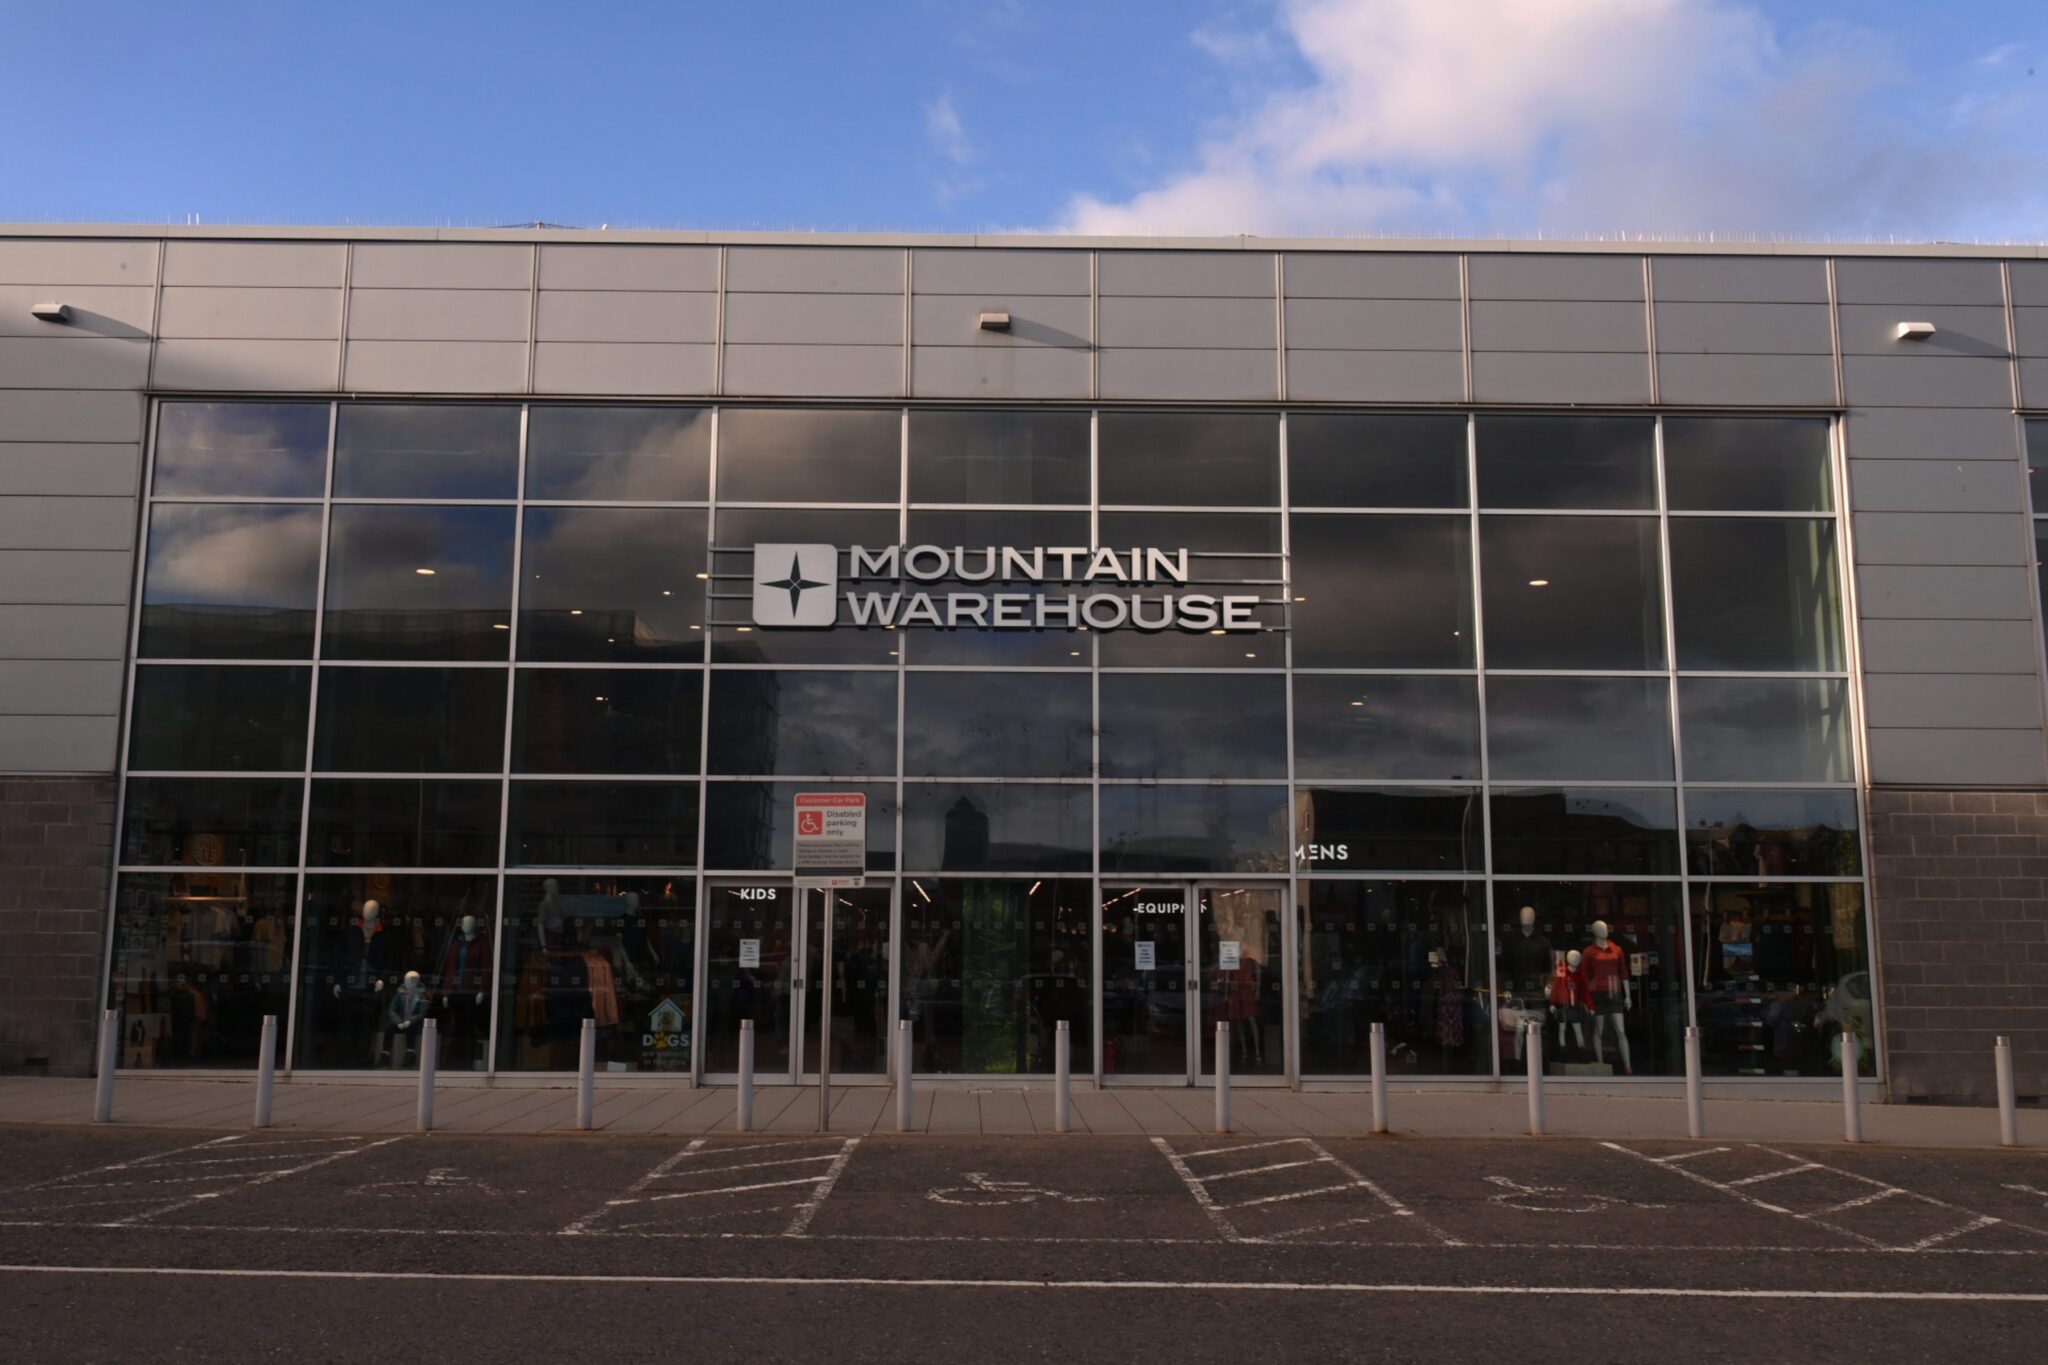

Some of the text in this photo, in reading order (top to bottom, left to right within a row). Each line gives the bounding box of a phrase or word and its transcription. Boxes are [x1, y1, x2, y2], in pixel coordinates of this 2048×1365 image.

[850, 544, 1188, 582] MOUNTAIN
[846, 592, 1262, 630] WAREHOUSE
[826, 810, 862, 818] Disabled
[826, 819, 857, 828] parking
[826, 829, 844, 837] only
[1294, 844, 1349, 860] MENS
[740, 888, 776, 900] KIDS
